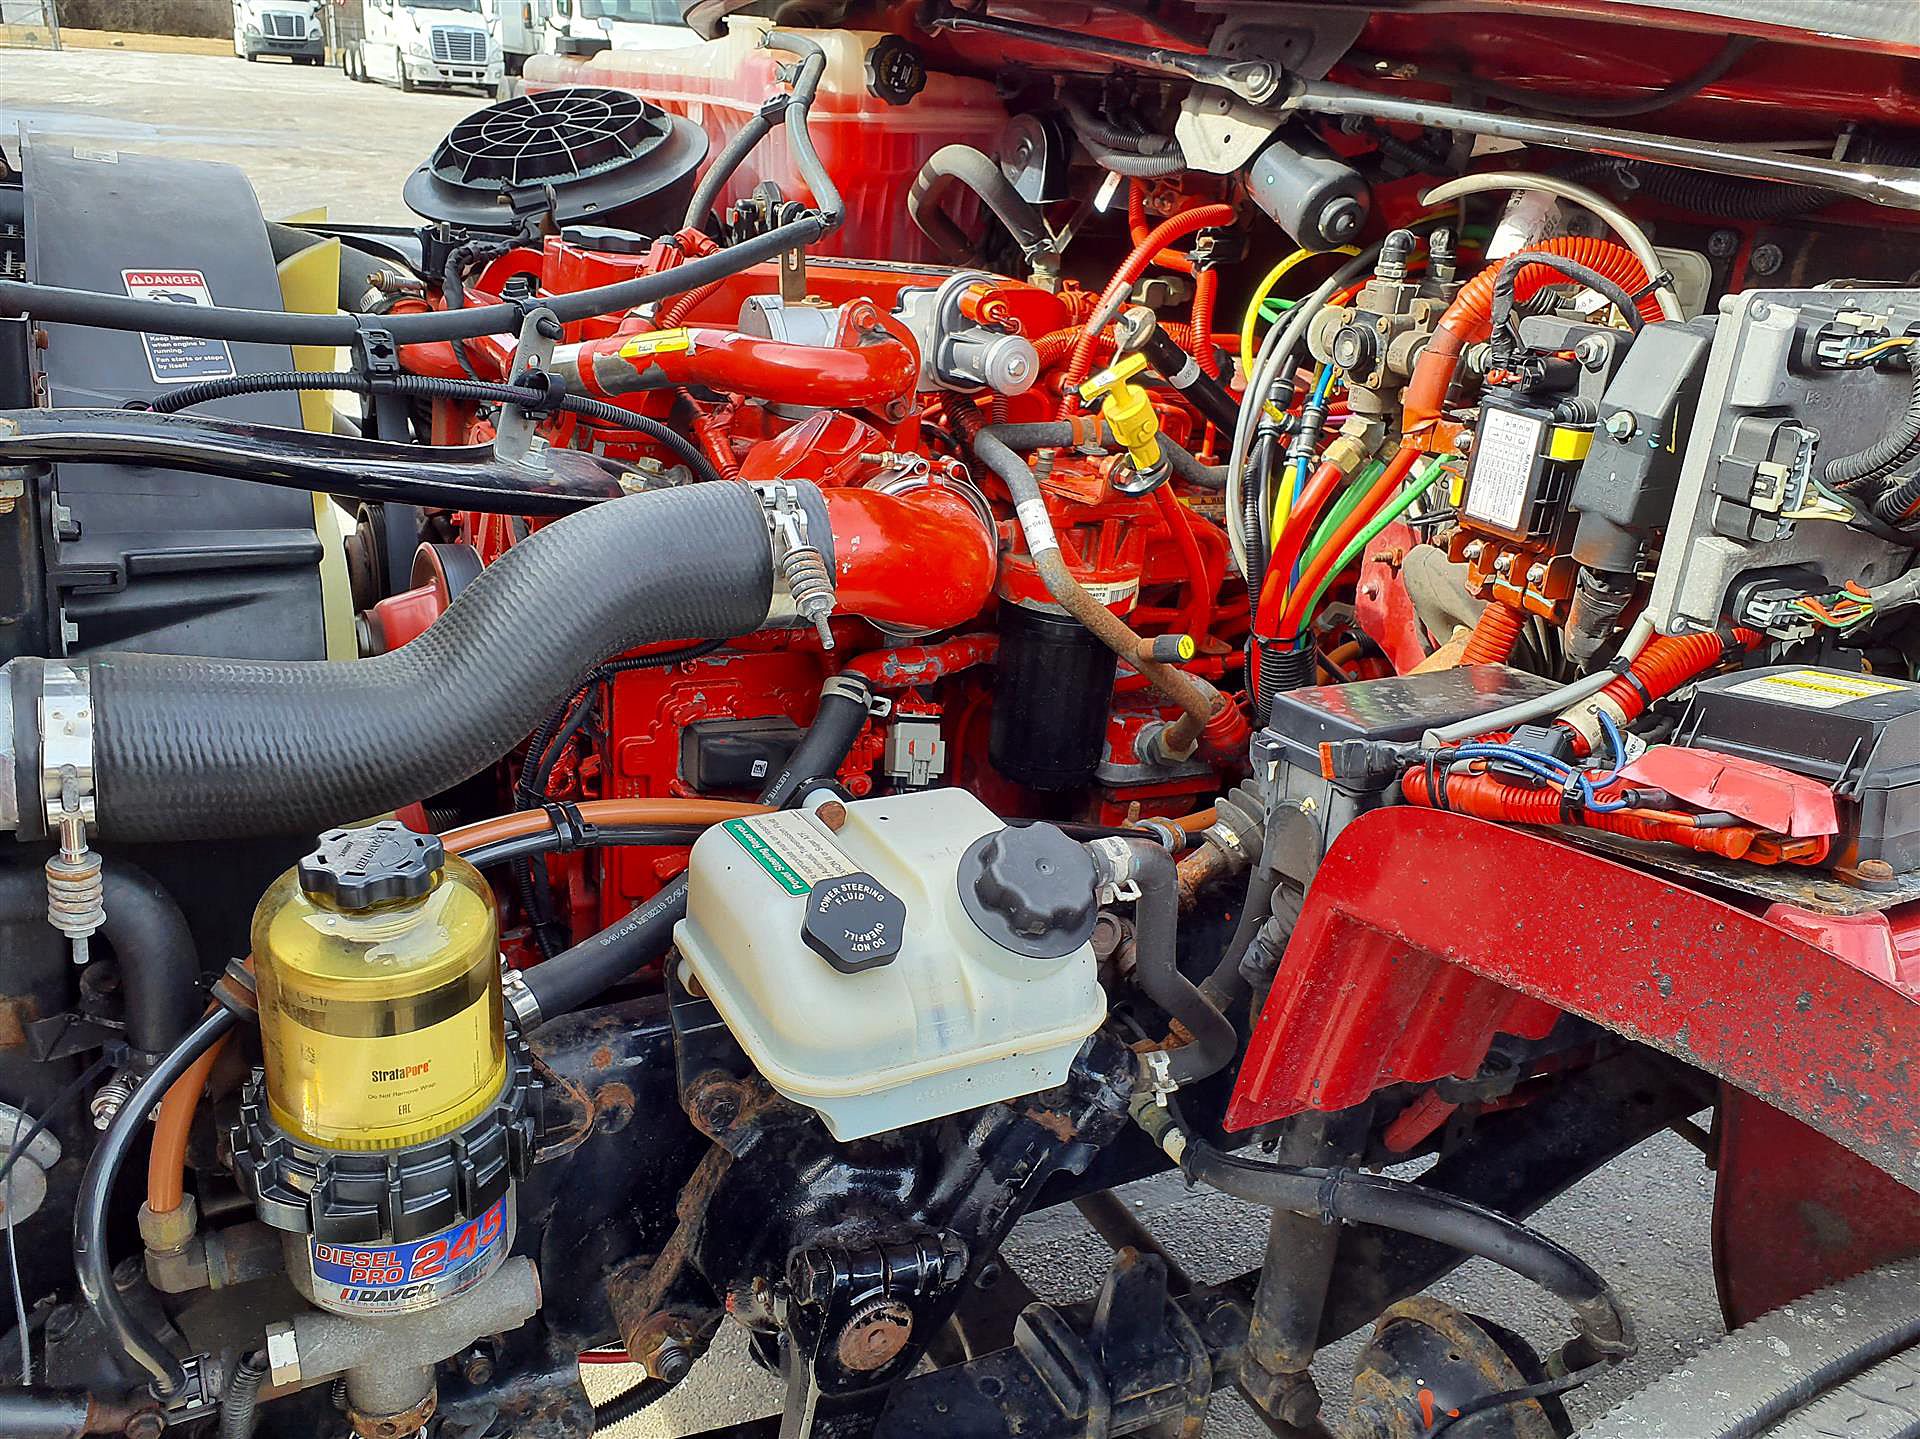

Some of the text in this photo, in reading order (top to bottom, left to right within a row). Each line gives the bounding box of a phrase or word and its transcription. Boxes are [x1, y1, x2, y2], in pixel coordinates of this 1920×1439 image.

[145, 275, 201, 285] DANGER
[172, 341, 198, 349] engine
[733, 823, 804, 890] Power Steering Reservoir
[819, 883, 885, 914] POWER STEERING
[835, 892, 866, 907] FLUID
[843, 922, 886, 943] OVERFILL
[850, 936, 887, 952] DO NOT
[371, 1061, 430, 1083] StrataPore
[407, 1198, 503, 1281] 245
[315, 1243, 402, 1268] DIESEL
[350, 1266, 405, 1285] PRO
[358, 1282, 434, 1302] DAVCO
